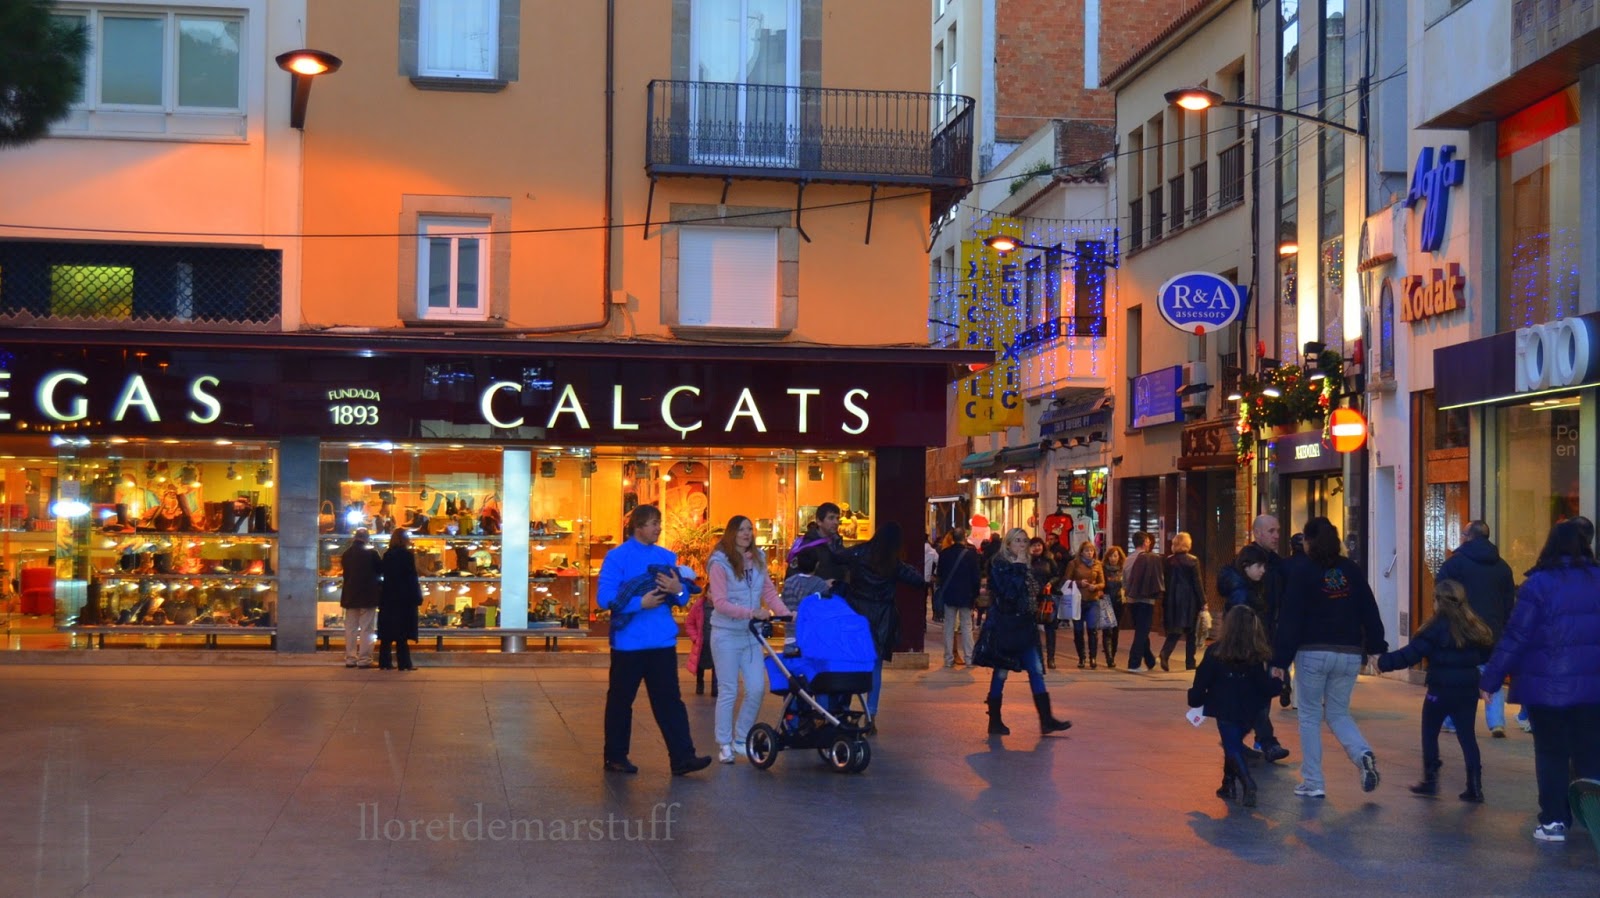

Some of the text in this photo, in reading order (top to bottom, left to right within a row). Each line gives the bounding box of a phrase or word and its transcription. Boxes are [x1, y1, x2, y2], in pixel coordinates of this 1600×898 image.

[1401, 145, 1466, 253] Agfa
[1171, 284, 1230, 310] R&A
[1400, 262, 1466, 323] Kodak
[1175, 310, 1226, 319] assessors
[1515, 316, 1590, 393] FOTO
[327, 388, 381, 402] FUNDADA
[329, 405, 379, 426] 1893
[480, 381, 871, 440] CALÇATS
[1556, 445, 1576, 457] en
